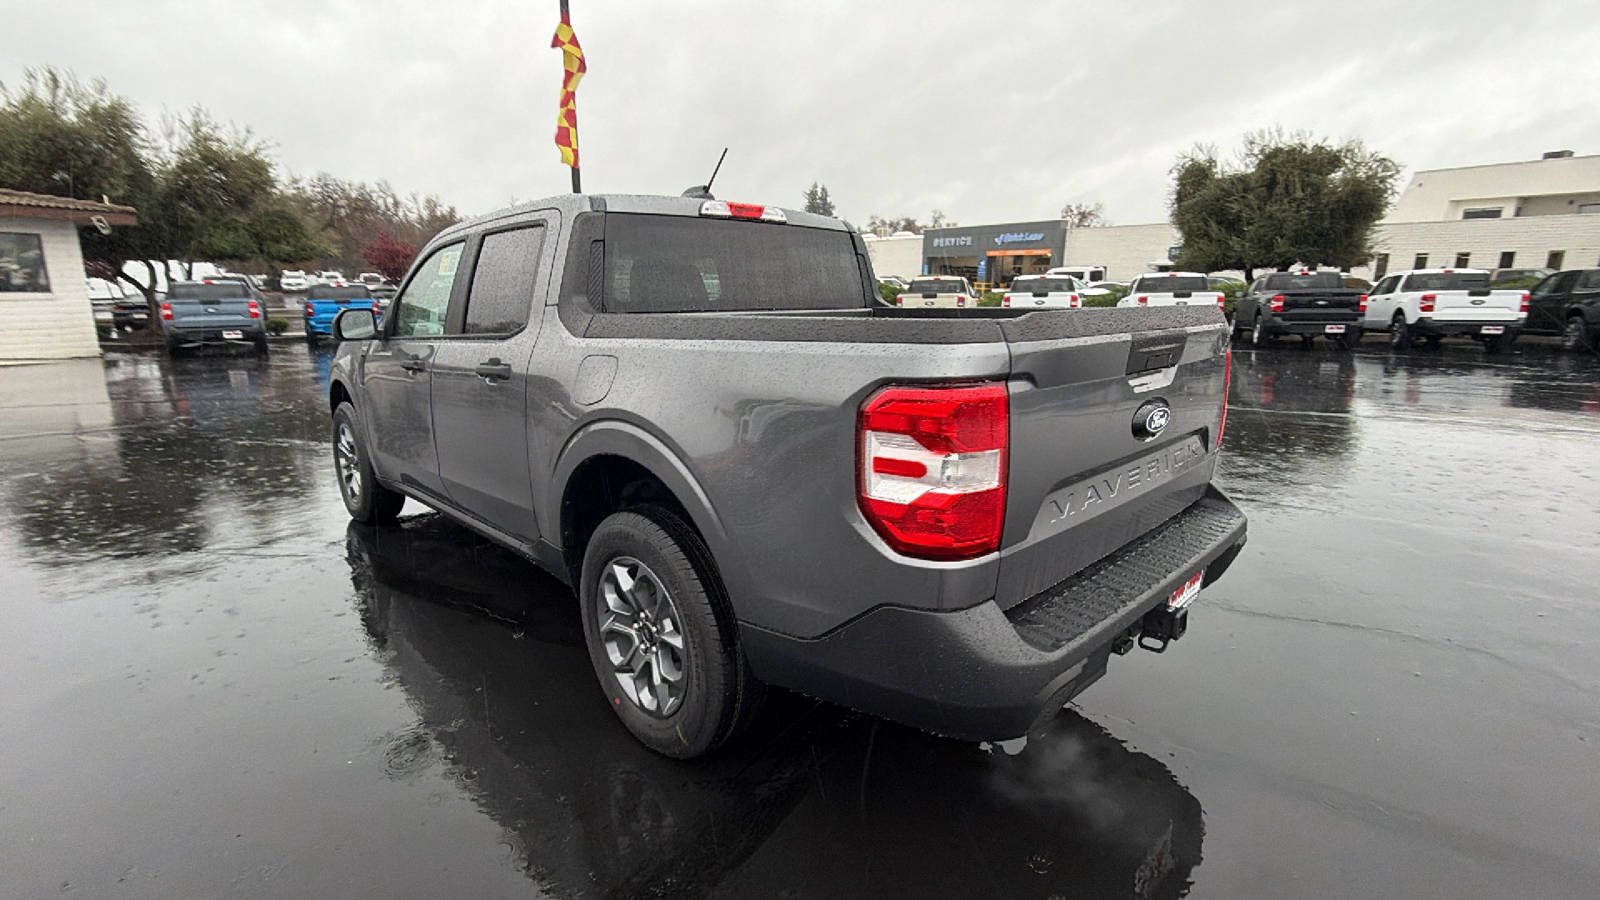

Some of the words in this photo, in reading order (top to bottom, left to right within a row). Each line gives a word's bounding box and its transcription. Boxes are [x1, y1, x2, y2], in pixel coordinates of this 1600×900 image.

[933, 236, 972, 247] SERVICE
[1151, 411, 1168, 429] Ford
[1050, 442, 1198, 523] MAVERICK
